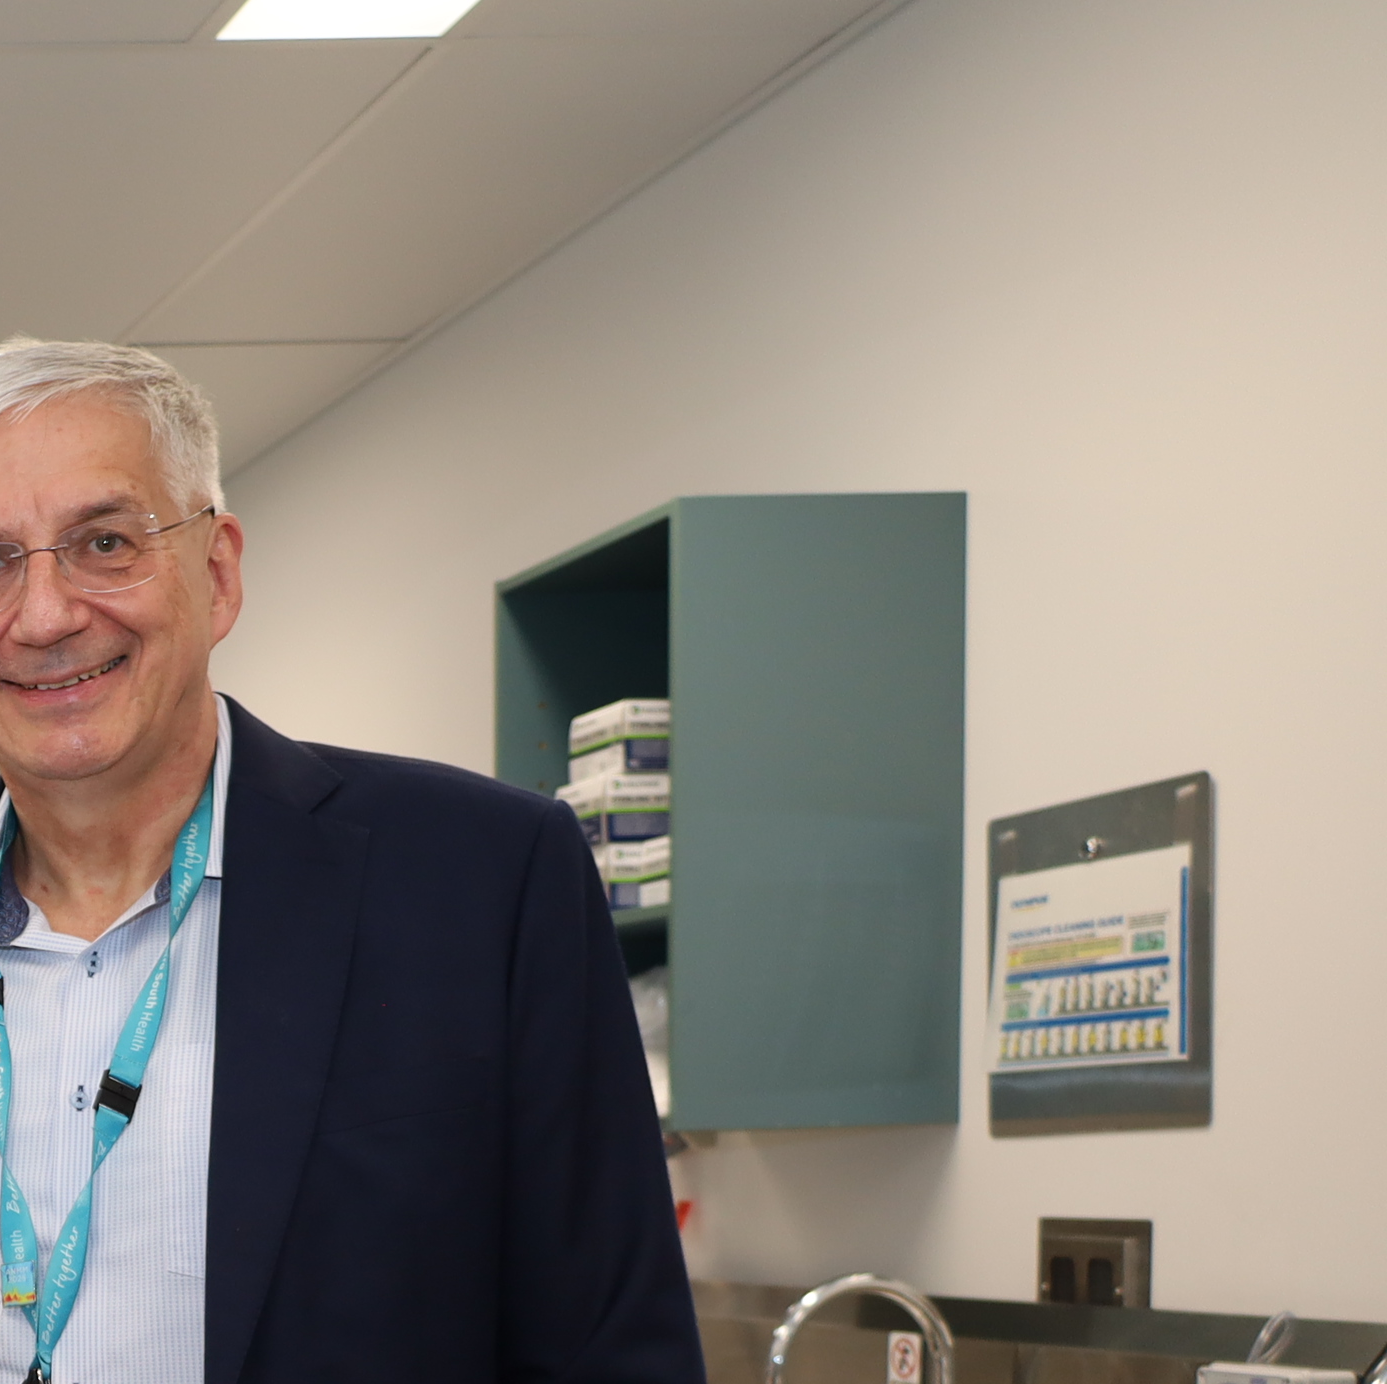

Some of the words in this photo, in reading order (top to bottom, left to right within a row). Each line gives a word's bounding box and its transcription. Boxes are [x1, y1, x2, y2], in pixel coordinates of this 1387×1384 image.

[146, 972, 164, 1009] South
[130, 1011, 153, 1053] Health
[10, 1229, 25, 1261] ealth
[52, 1225, 79, 1290] together
[41, 1291, 64, 1345] Better
